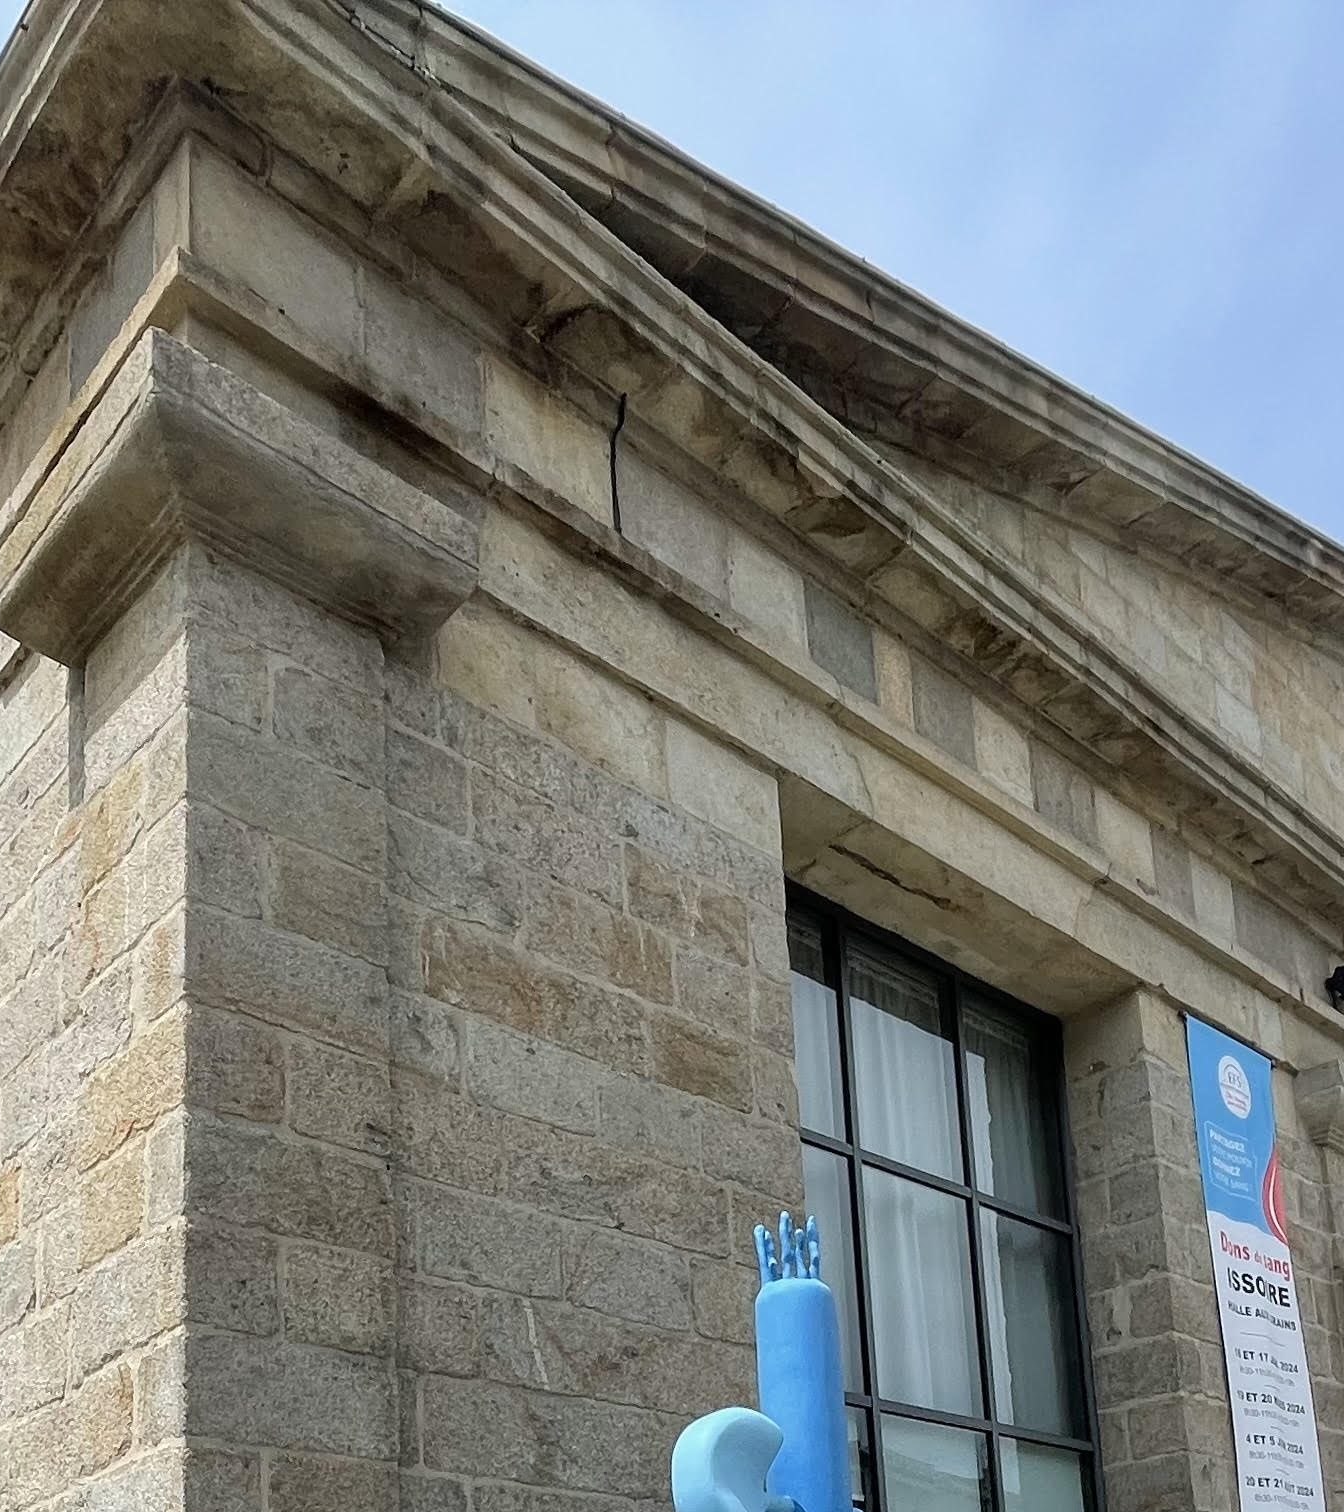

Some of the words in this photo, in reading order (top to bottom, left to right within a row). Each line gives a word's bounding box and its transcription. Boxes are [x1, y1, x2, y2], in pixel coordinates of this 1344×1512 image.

[1221, 1231, 1250, 1261] Dons
[1227, 1267, 1291, 1308] ISSOIRE
[1270, 1314, 1296, 1331] RAINS
[1243, 1350, 1255, 1360] ET
[1259, 1352, 1269, 1362] 17
[1246, 1392, 1258, 1402] ET
[1261, 1393, 1273, 1404] 20
[1246, 1433, 1251, 1444] 4
[1254, 1434, 1266, 1444] ET
[1258, 1477, 1270, 1487] ET
[1274, 1478, 1283, 1488] 21
